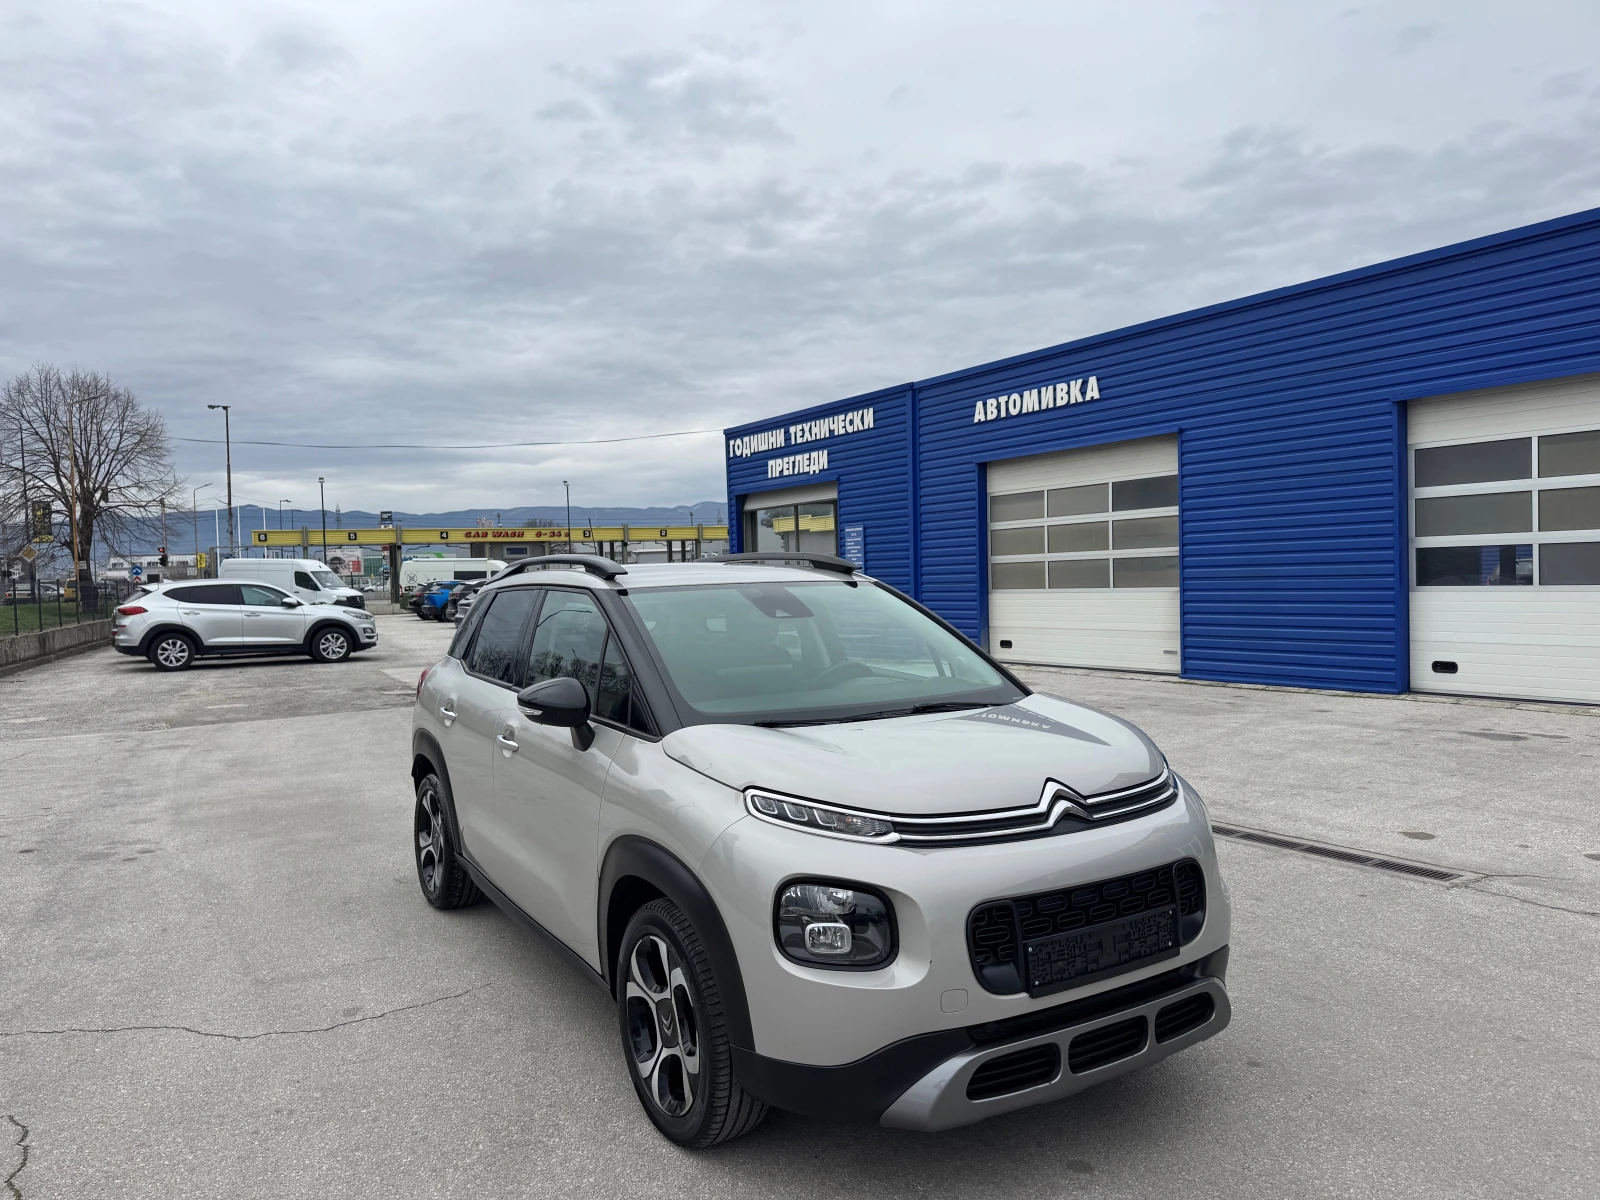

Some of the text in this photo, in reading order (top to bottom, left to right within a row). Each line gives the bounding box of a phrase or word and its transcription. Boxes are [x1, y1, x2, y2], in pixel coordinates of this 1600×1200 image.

[973, 375, 1101, 424] АВТОМИВКА
[729, 407, 875, 458] ГОДИШНИ ТЕХНИЧЕСКИ
[767, 449, 829, 479] ПРЕГЛЕДИ
